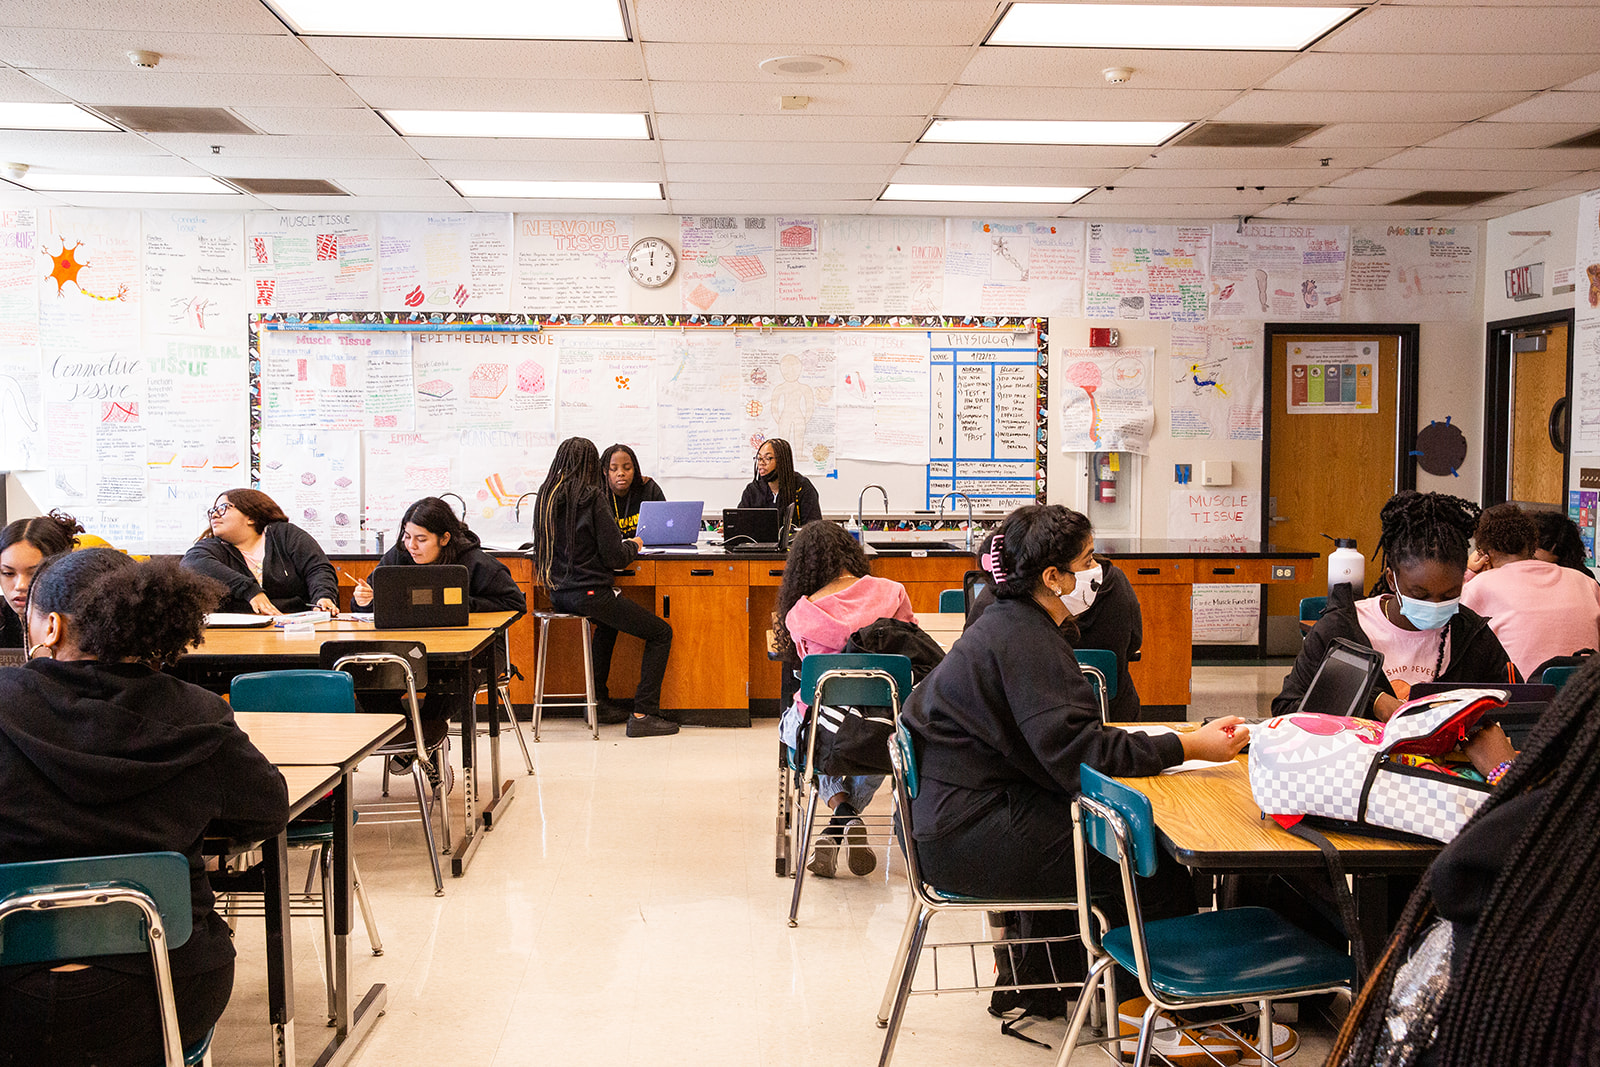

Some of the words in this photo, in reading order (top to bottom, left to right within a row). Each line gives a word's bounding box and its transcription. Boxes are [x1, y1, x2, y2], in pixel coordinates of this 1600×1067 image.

[280, 215, 316, 227] MUSCLE
[318, 214, 351, 226] TISSUE
[522, 219, 617, 236] NERVOUS
[1279, 226, 1316, 238] TISSUE
[553, 234, 630, 251] TISSUE
[911, 246, 943, 259] FUNCTION
[1510, 267, 1530, 296] EXIT
[296, 335, 332, 346] Muscle
[338, 336, 372, 346] Tissue
[419, 334, 498, 345] EPITHELIAL
[500, 334, 554, 345] TISSUE
[839, 335, 867, 346] MUSCLE
[873, 336, 905, 348] TISSUE
[947, 334, 1016, 346] PHYSIOLOGY
[52, 353, 142, 379] Connective
[147, 357, 208, 377] TISSUE
[67, 382, 139, 402] Tissue
[1189, 495, 1248, 508] MUSCLE
[1191, 511, 1244, 524] TISSUE
[1386, 665, 1408, 677] SHIP
